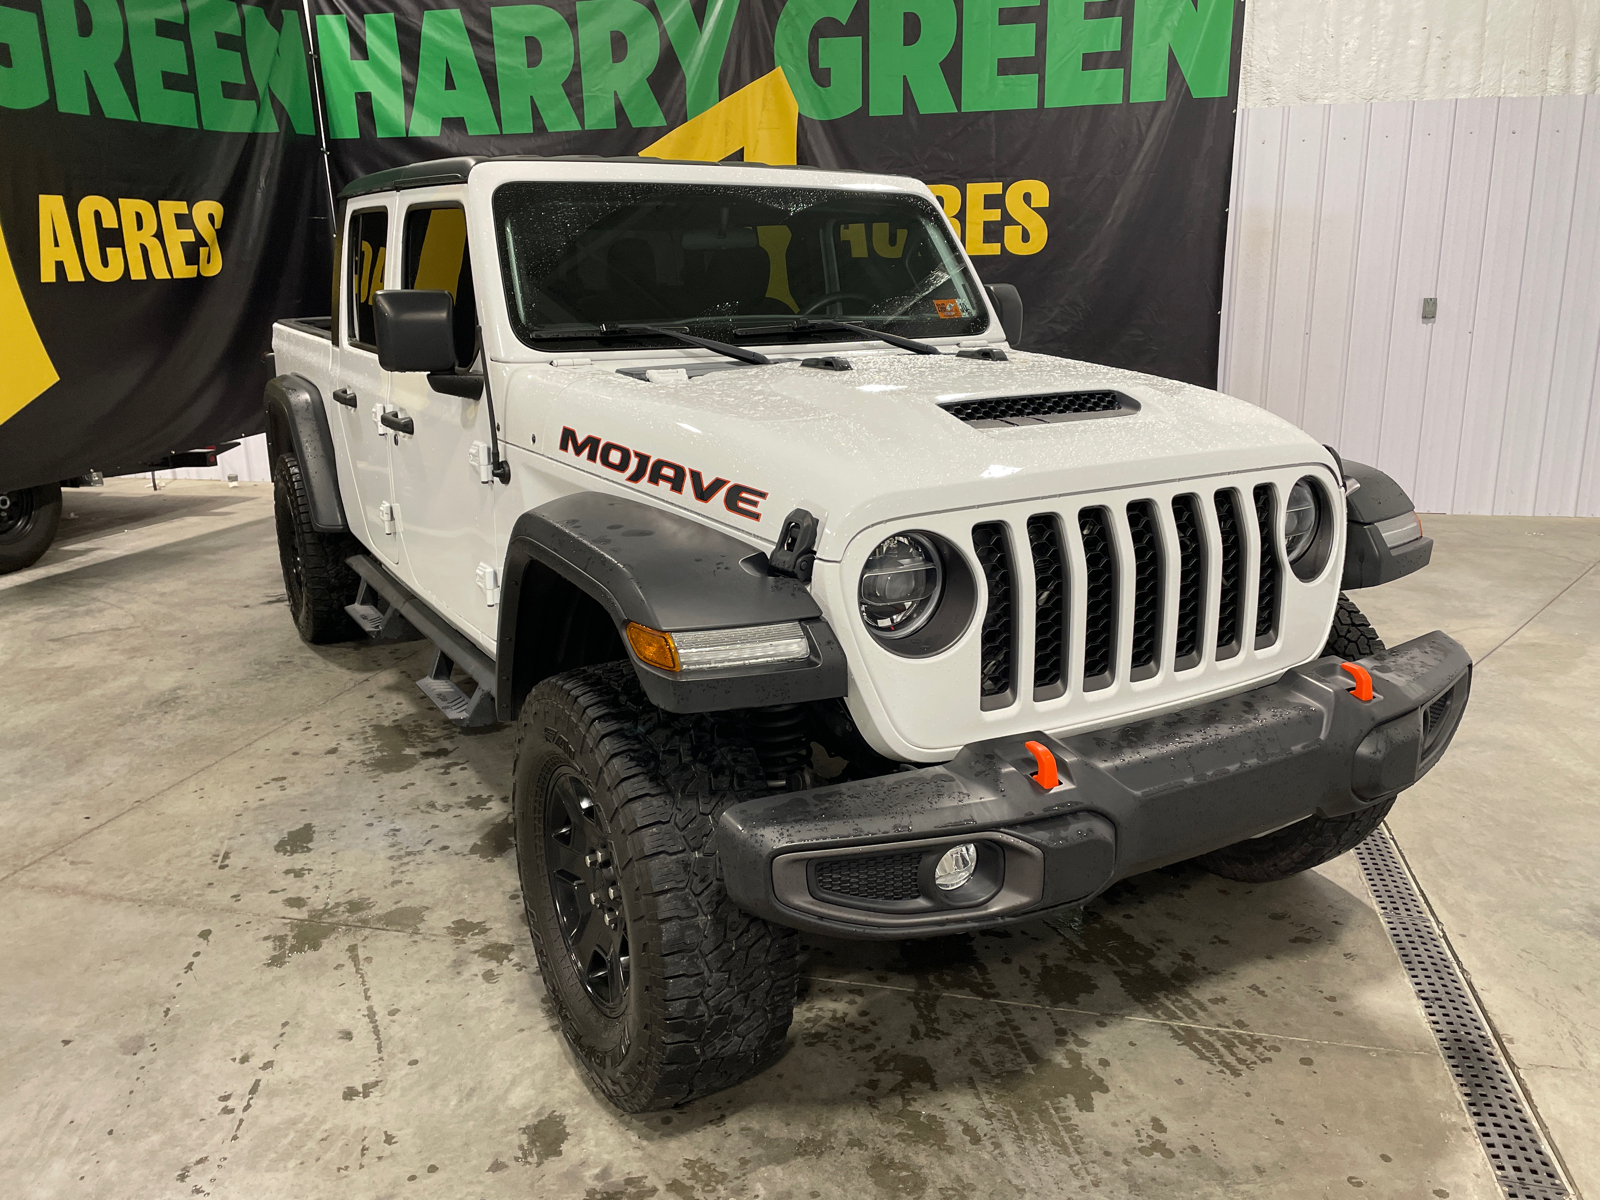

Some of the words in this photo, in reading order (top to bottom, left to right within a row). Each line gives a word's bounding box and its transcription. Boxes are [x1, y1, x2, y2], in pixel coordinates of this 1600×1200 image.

[316, 0, 739, 139] HARRY
[774, 0, 1233, 121] GREEN
[38, 194, 224, 283] ACRES
[559, 425, 768, 522] MOJAVE
